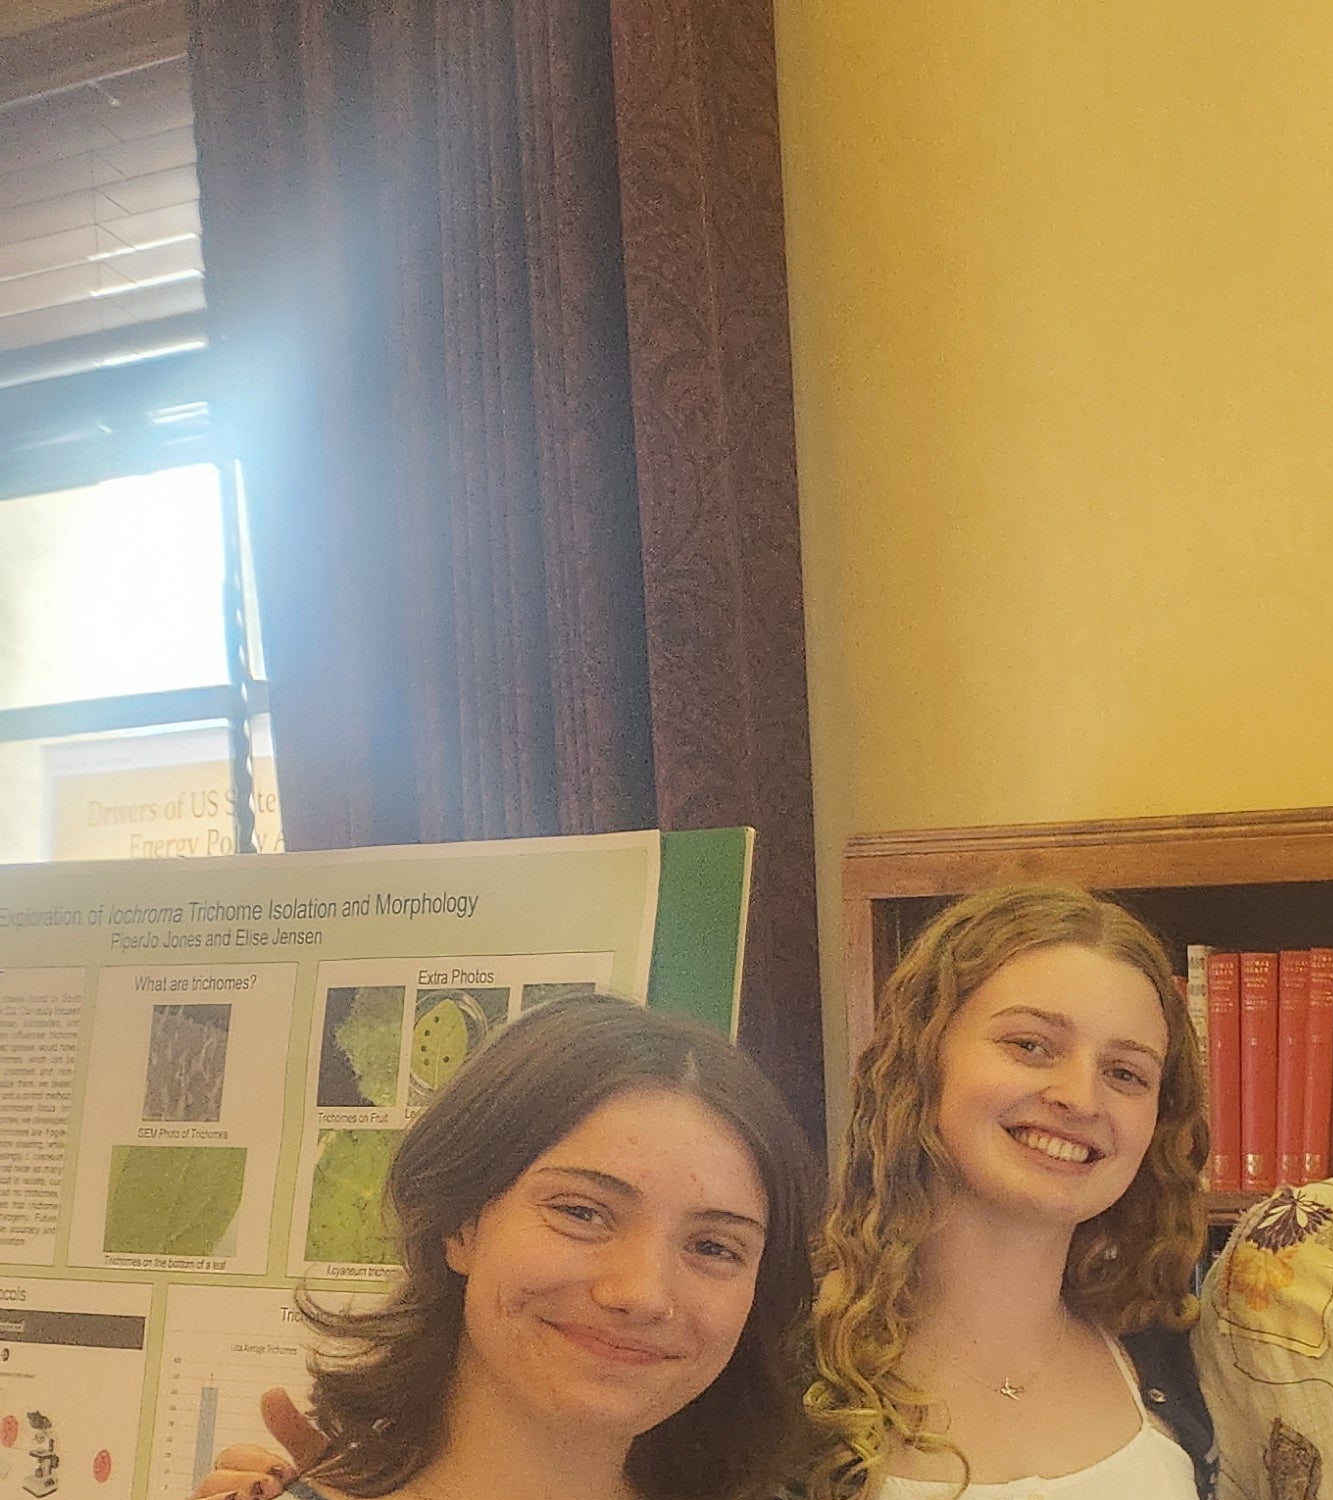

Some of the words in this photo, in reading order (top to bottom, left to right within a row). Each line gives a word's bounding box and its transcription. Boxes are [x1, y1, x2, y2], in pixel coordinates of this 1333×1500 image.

[225, 788, 277, 814] Ste
[88, 905, 104, 926] of
[189, 899, 262, 923] Trichome
[268, 897, 337, 920] Isolation
[342, 896, 369, 917] and
[376, 892, 479, 920] Morphology
[162, 931, 201, 949] Jones
[205, 931, 231, 948] and
[235, 929, 268, 947] Elise
[272, 929, 322, 946] Jensen
[134, 975, 169, 993] What
[173, 978, 189, 992] are
[192, 973, 257, 993] trichomes?
[418, 969, 447, 985] Extra
[451, 968, 495, 986] Photos
